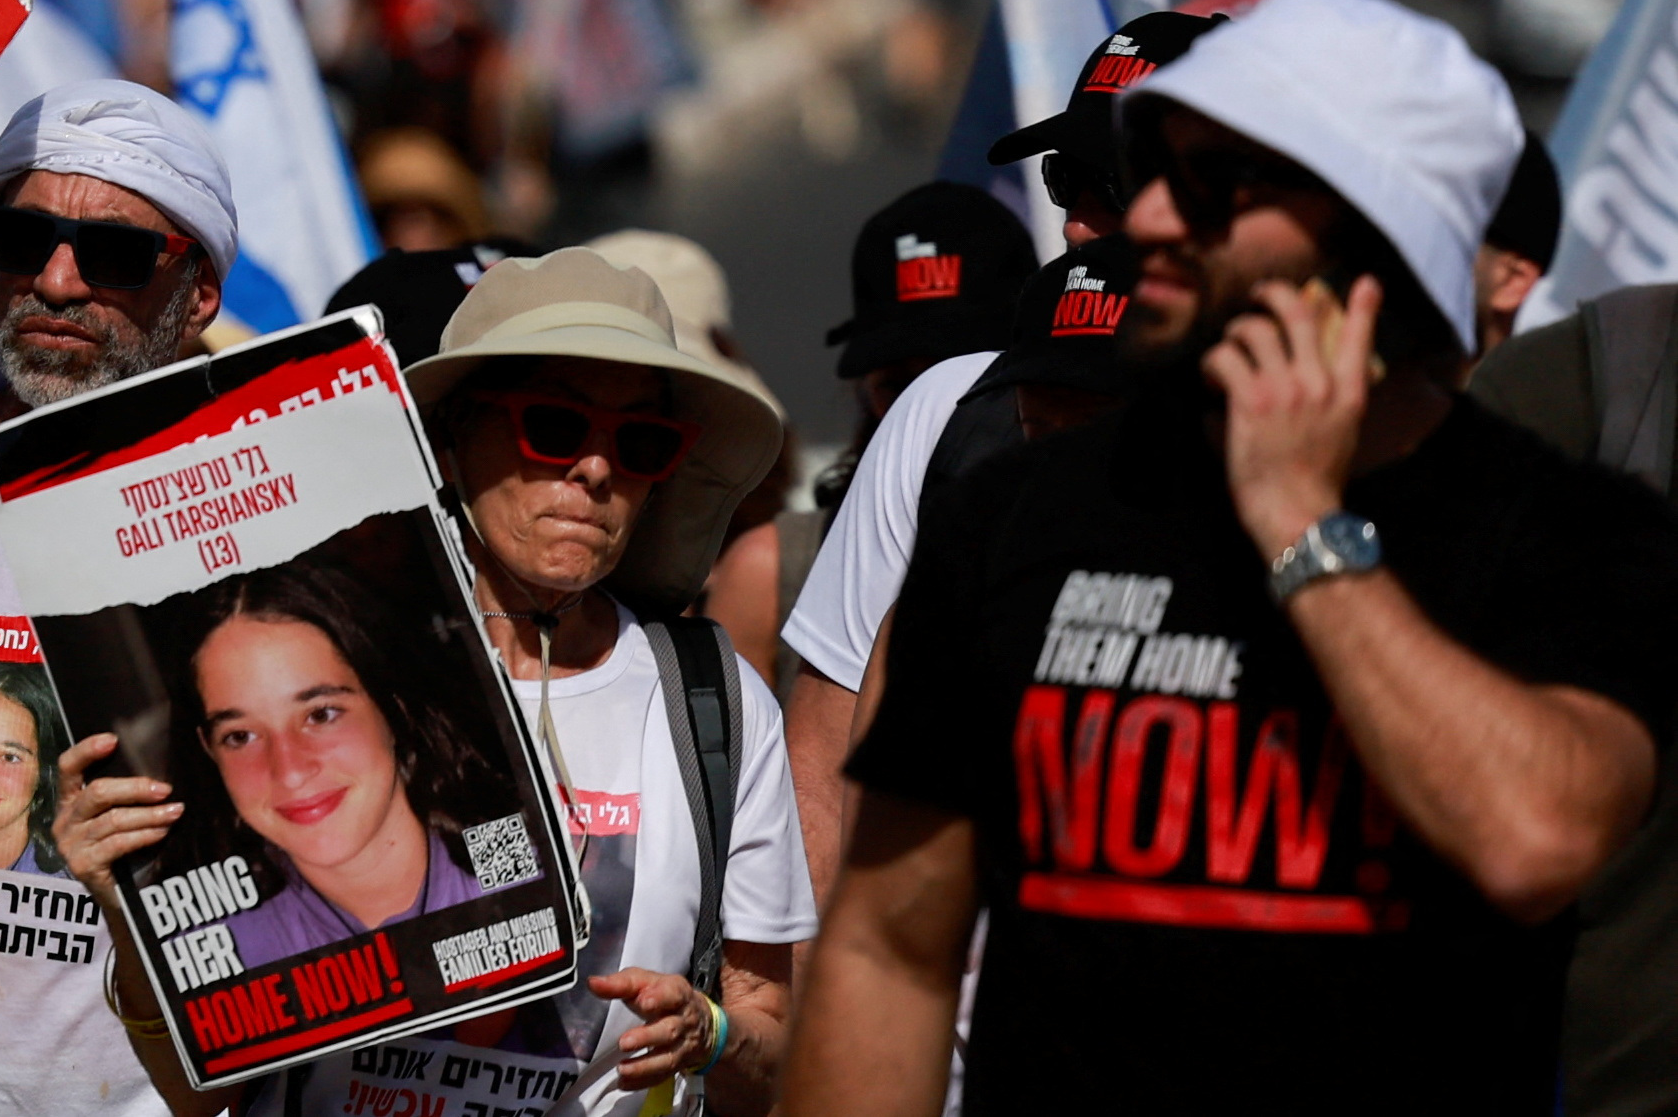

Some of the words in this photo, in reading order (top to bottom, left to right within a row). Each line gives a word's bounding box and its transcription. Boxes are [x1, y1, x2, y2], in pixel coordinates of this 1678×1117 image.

[1053, 290, 1129, 327] NOW
[232, 445, 270, 479] גלי
[115, 518, 164, 558] GALI
[163, 473, 298, 543] TARSHANSKY
[197, 531, 241, 575] (13)
[1050, 569, 1173, 635] BRING
[1034, 627, 1140, 688] THEM
[1130, 632, 1244, 700] HOME
[598, 801, 630, 826] גלי
[139, 855, 259, 939] BRING
[160, 923, 244, 993] HER
[432, 927, 489, 962] HOSTAGES
[487, 920, 511, 945] AND
[509, 906, 556, 938] MISSING
[438, 942, 510, 987] FAMILIES
[508, 925, 561, 965] FORUM
[184, 973, 297, 1053] HOME
[291, 932, 404, 1021] NOW!
[351, 1045, 435, 1081] אותם
